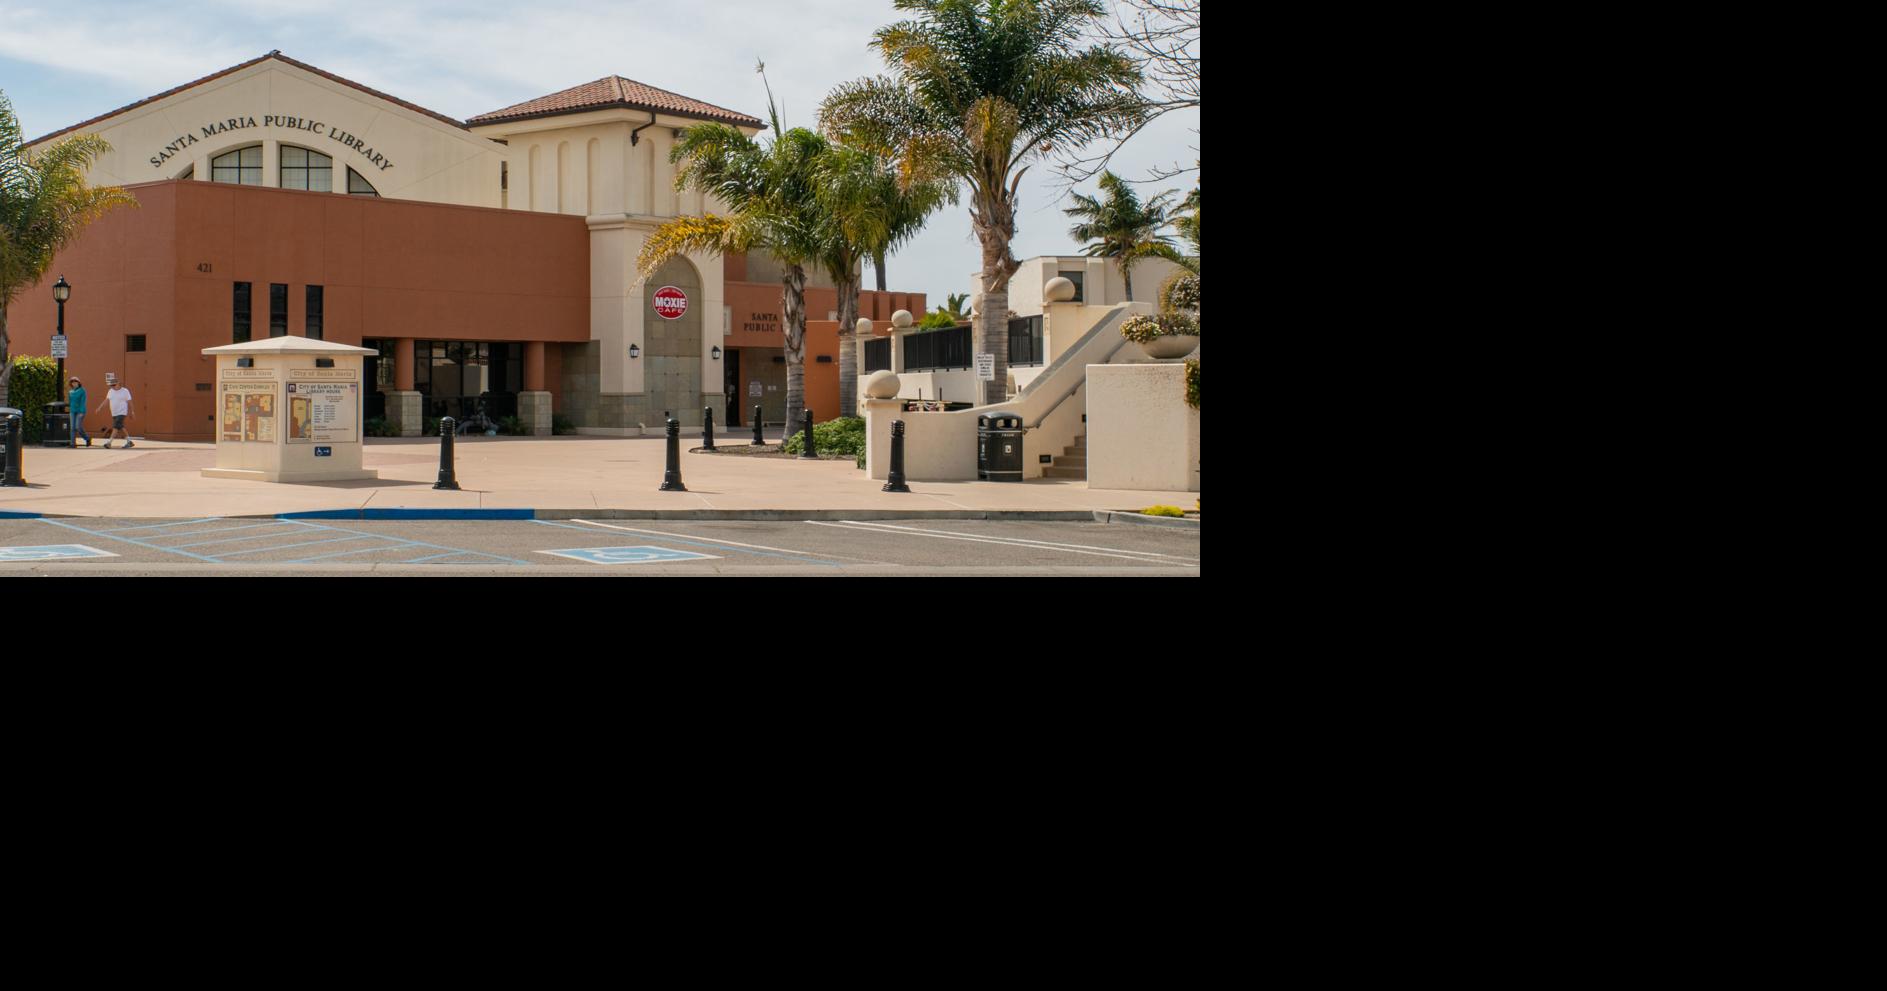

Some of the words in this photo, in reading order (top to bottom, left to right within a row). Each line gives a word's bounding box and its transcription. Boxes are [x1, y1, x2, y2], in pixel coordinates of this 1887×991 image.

[150, 133, 199, 168] SANTA
[201, 116, 257, 138] MARIA
[264, 115, 325, 134] PUBLIC
[328, 127, 394, 171] LIBRARY
[196, 263, 212, 272] 421
[655, 296, 686, 308] MOXIE
[752, 312, 777, 321] SANTA
[744, 323, 775, 332] PUBLIC
